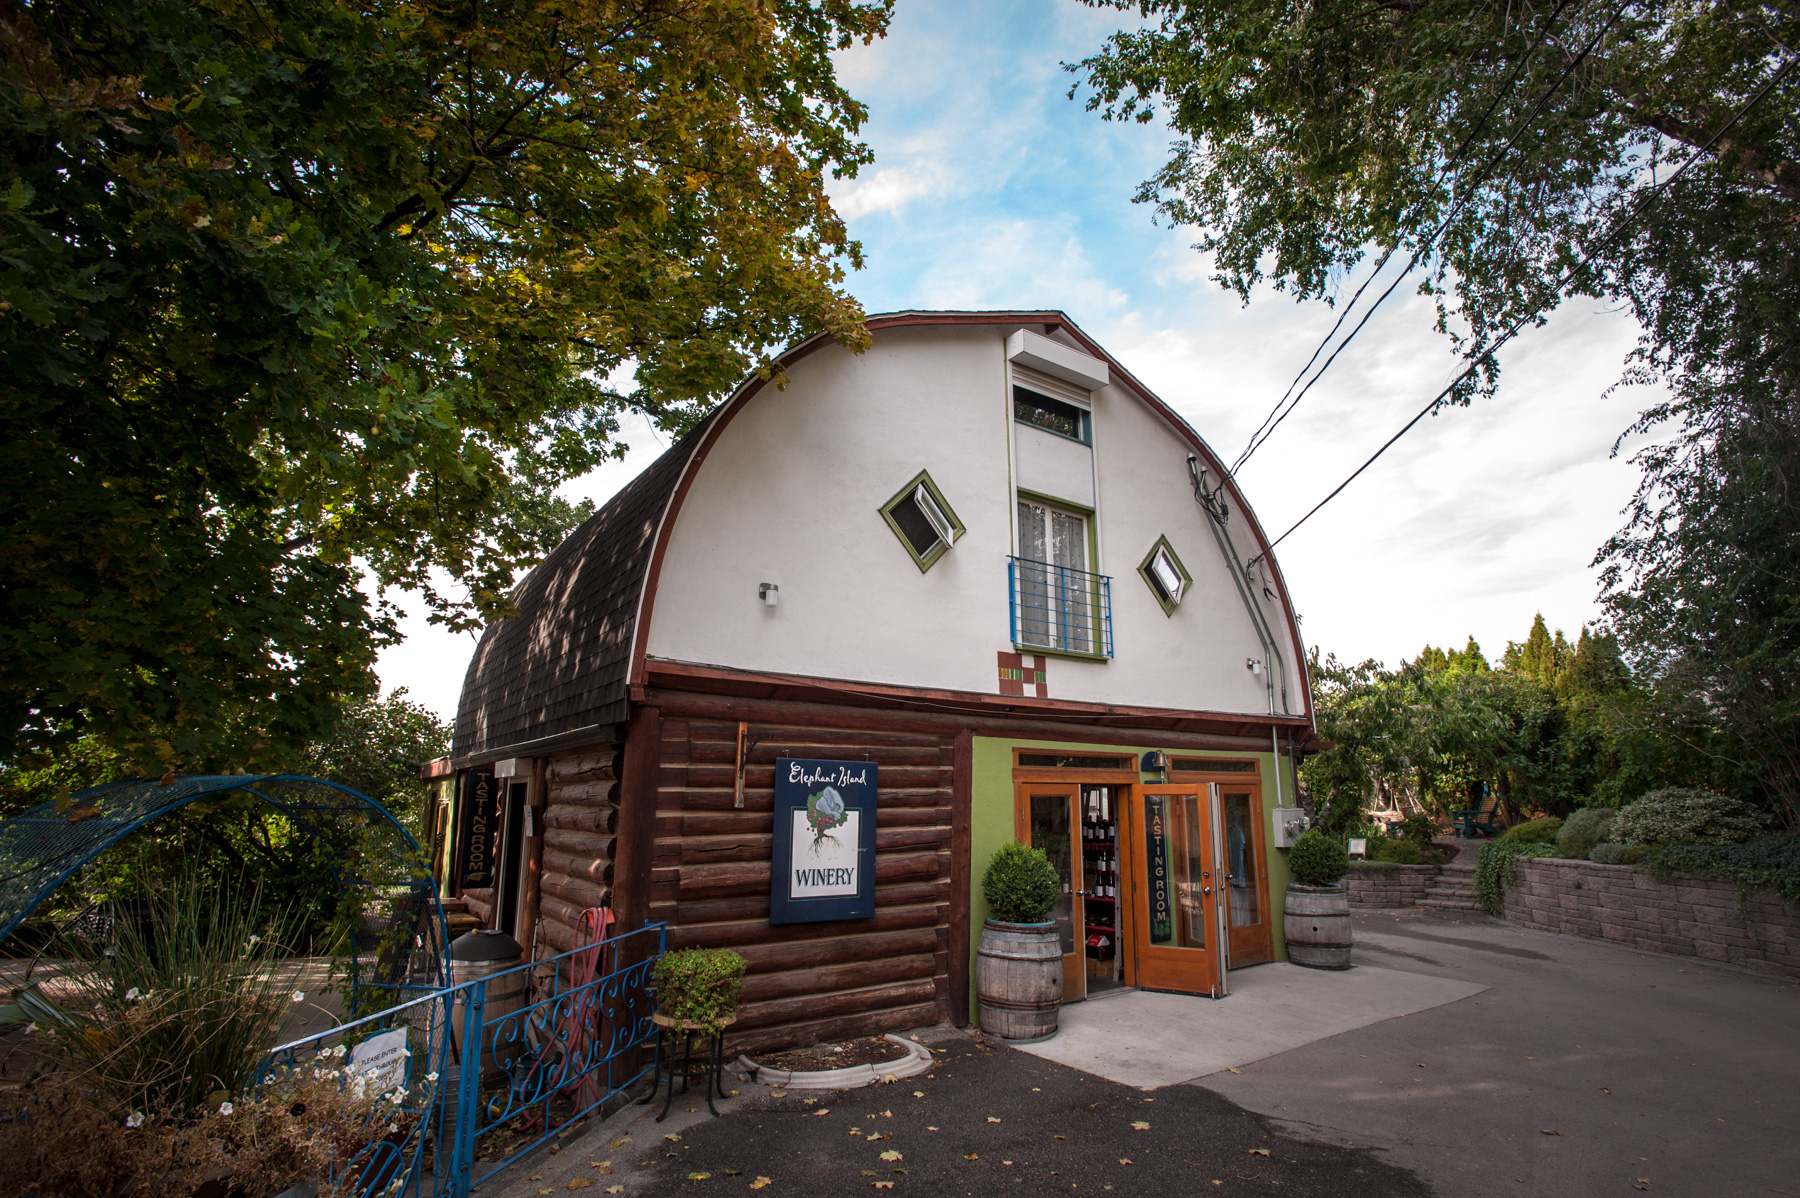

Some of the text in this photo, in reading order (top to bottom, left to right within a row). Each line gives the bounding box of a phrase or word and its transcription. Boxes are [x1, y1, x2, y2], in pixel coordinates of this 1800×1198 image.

[789, 762, 867, 787] Elephant Island
[469, 772, 490, 871] TASTING ROOM
[1152, 805, 1166, 922] TASTING ROOM
[795, 867, 855, 888] WINERY
[361, 1047, 397, 1065] PLEASE ENTER
